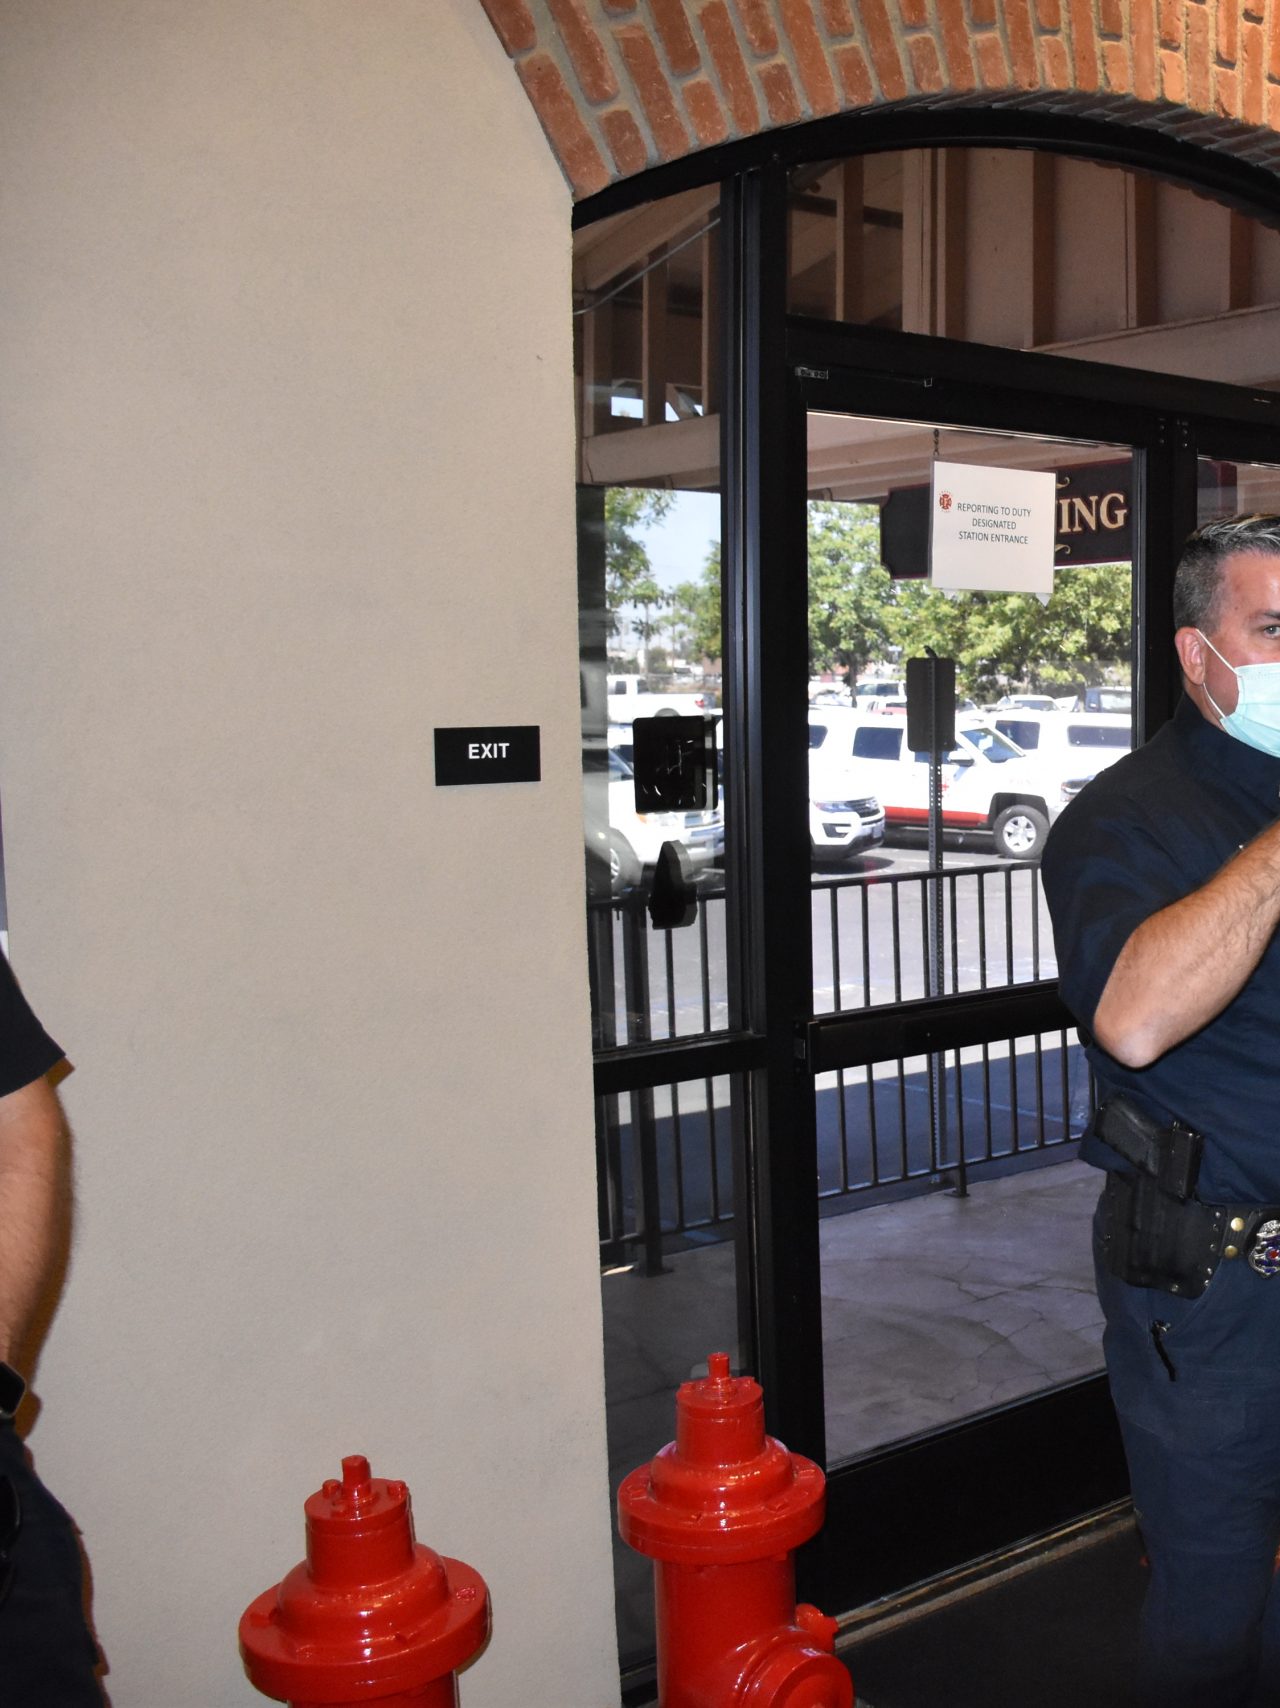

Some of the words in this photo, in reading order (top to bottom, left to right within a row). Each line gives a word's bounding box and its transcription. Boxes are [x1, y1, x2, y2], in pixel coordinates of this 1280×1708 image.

[957, 502, 999, 515] REPORTING
[1000, 506, 1011, 516] TO
[1012, 507, 1032, 517] DUTY
[1059, 492, 1128, 533] ING
[972, 518, 1017, 530] DESIGNATED
[958, 530, 989, 542] STATION
[990, 534, 1029, 545] ENTRANCE
[468, 742, 510, 760] EXIT
